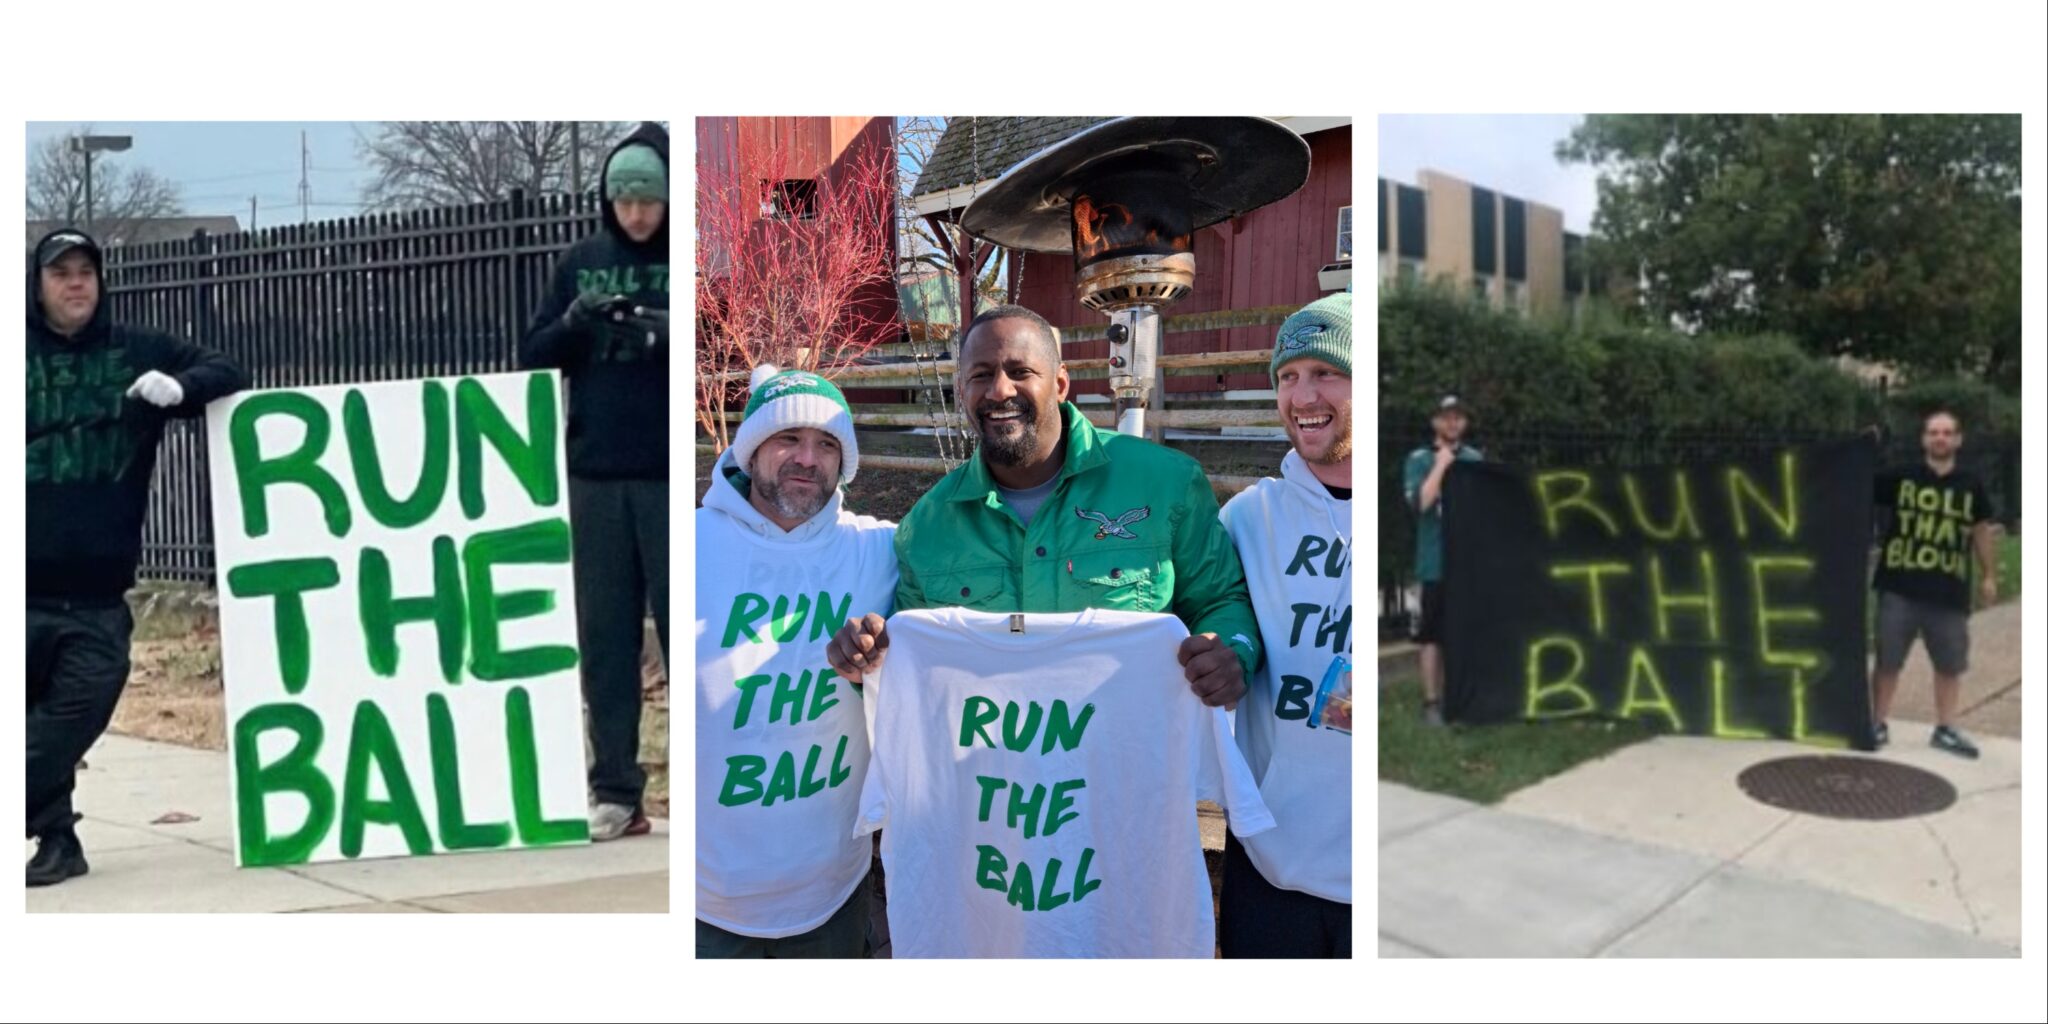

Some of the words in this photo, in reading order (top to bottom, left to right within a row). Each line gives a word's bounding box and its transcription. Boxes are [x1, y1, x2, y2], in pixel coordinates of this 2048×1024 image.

[229, 372, 560, 539] RUN
[1534, 453, 1800, 539] RUN
[1898, 479, 1974, 521] ROLL
[1897, 509, 1973, 552] THAT
[227, 517, 581, 696] THE
[720, 591, 852, 648] RUN
[1289, 603, 1352, 654] TH
[1549, 550, 1820, 668] THE
[733, 668, 840, 730] THE
[959, 695, 1096, 756] RUN
[1524, 636, 1849, 748] BALL
[235, 685, 592, 868] BALL
[718, 735, 852, 808] BALL
[976, 775, 1087, 840] THE
[976, 844, 1103, 912] BALL
